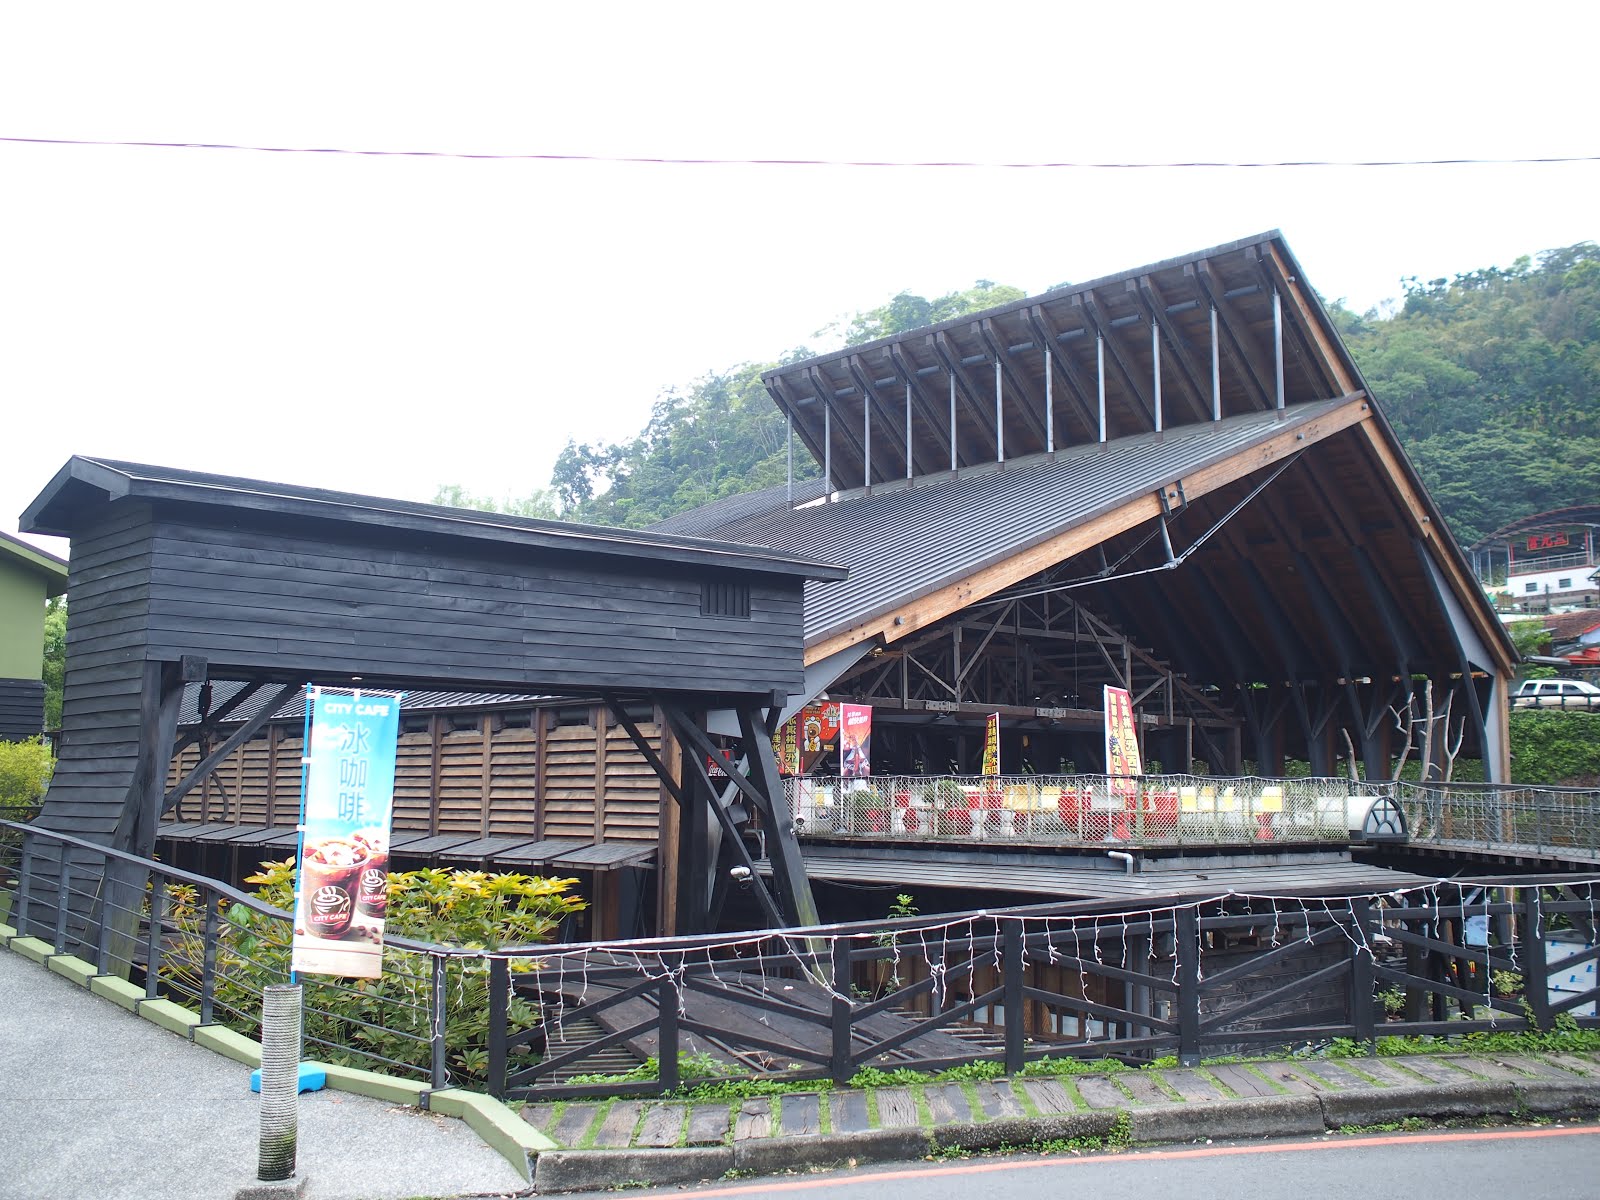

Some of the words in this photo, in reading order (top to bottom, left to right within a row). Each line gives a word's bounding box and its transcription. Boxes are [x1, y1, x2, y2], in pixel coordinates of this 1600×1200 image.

[323, 703, 353, 714] CITY
[355, 704, 389, 717] CAFE
[339, 723, 369, 822] 冰咖啡
[313, 914, 329, 922] CITY
[329, 913, 347, 921] CAFE
